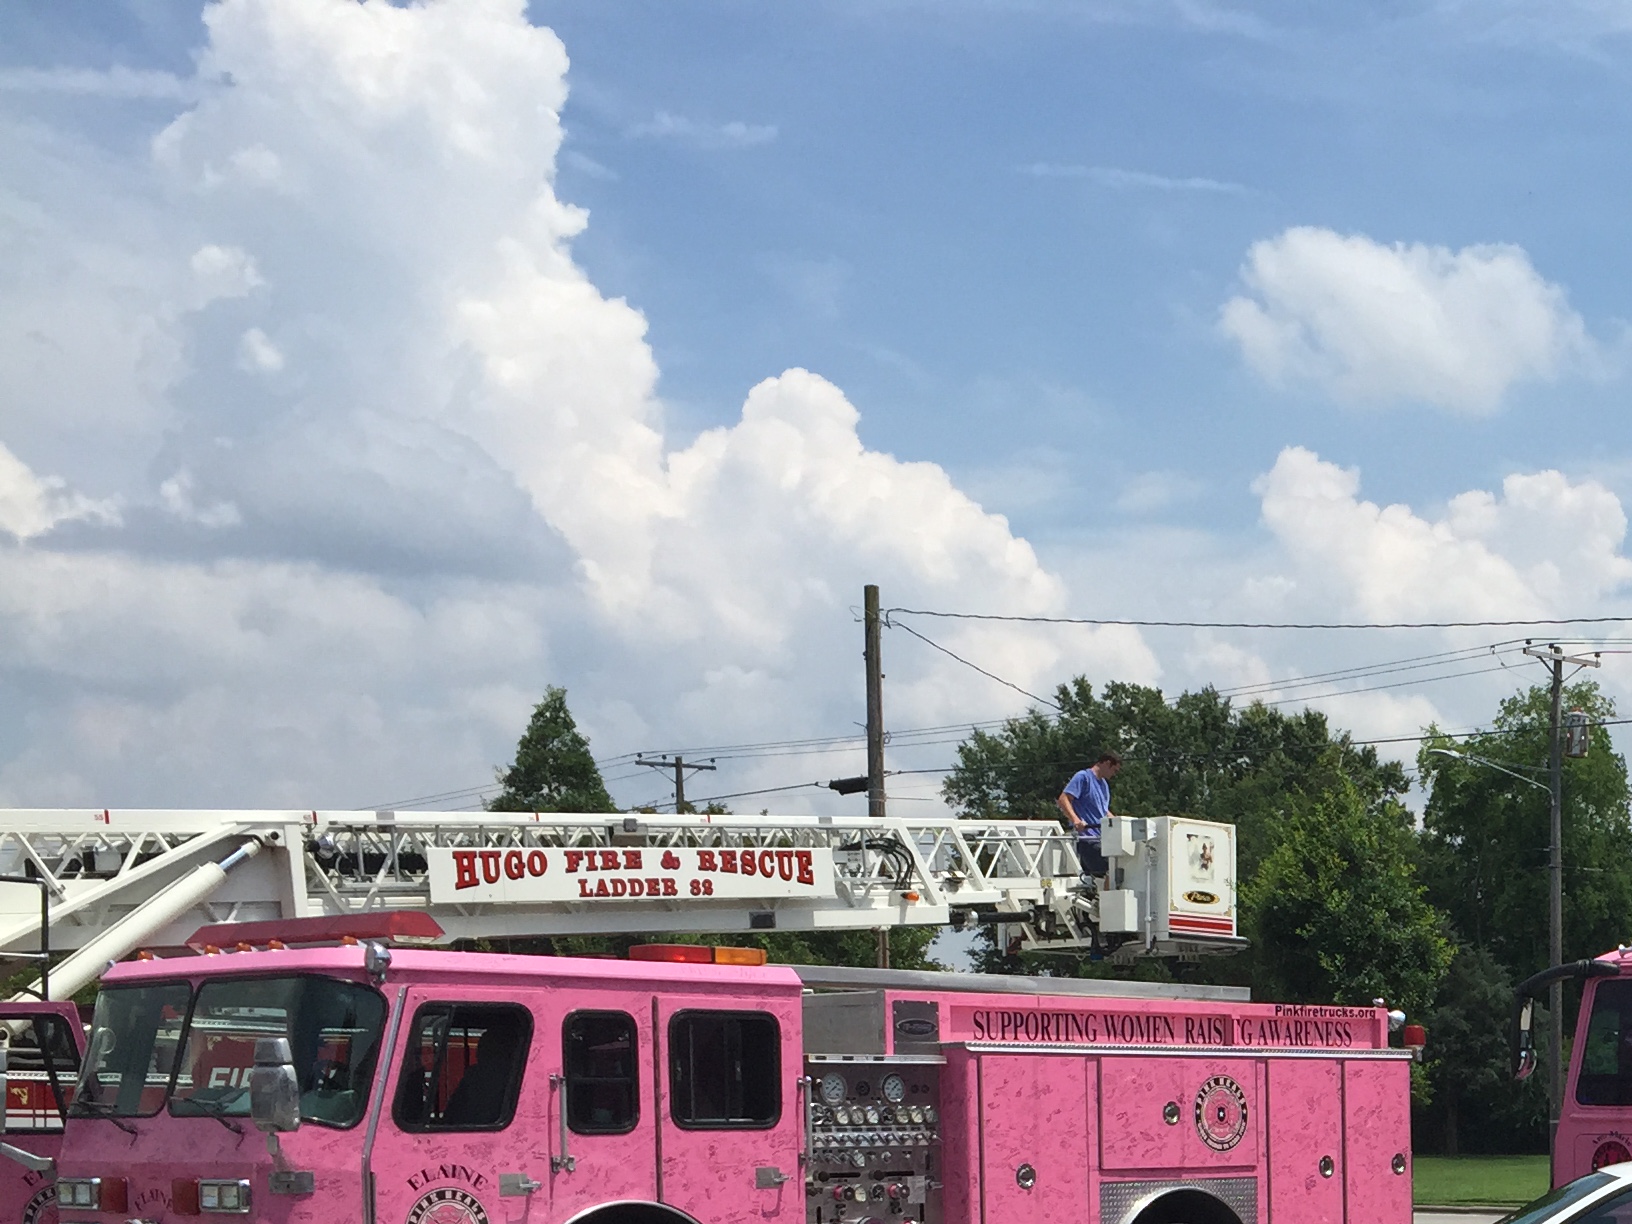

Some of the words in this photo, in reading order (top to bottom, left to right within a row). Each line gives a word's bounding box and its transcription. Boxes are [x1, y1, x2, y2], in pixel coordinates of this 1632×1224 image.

[452, 849, 548, 890] HUGO
[564, 849, 642, 874] FIRE
[660, 849, 681, 871] &
[696, 849, 815, 886] RESCUE
[578, 877, 679, 898] LADDER
[1274, 1004, 1376, 1020] Pinkfiretrucks.org
[973, 1009, 1098, 1042] SUPPORTING
[1102, 1012, 1176, 1044] WOMEN
[1257, 1018, 1352, 1048] AWARENESS
[406, 1164, 489, 1192] ELAINE
[409, 1192, 439, 1224] PINK
[445, 1190, 486, 1220] HEALS
